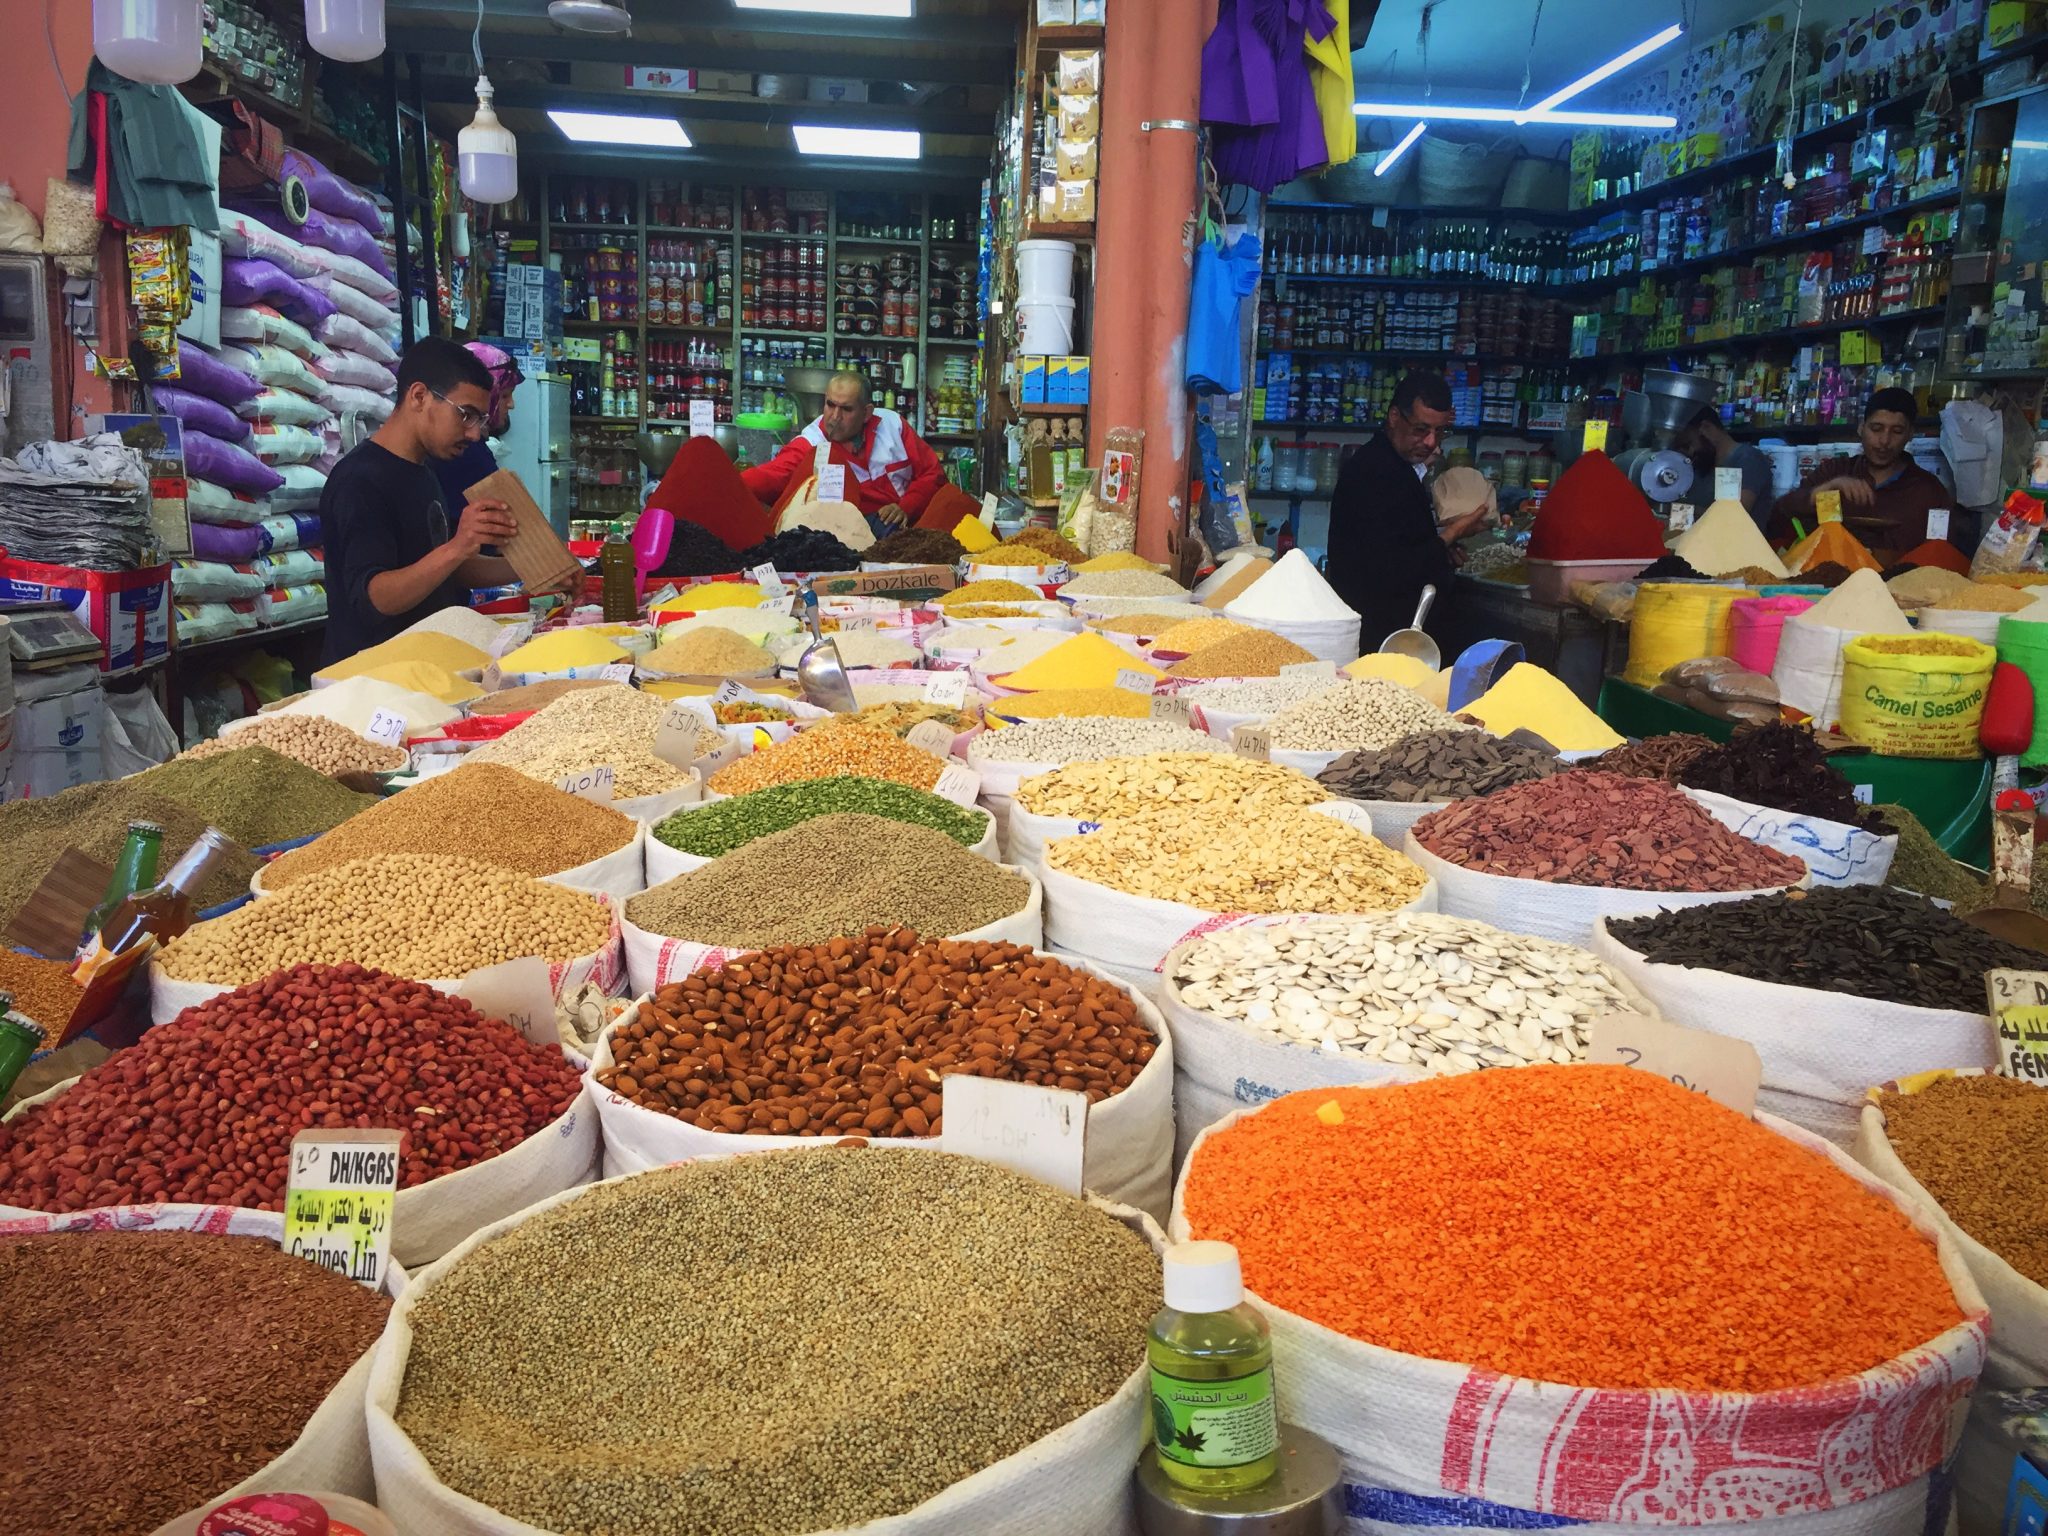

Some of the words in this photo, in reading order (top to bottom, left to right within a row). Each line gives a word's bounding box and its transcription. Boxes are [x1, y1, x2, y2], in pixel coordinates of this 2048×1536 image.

[862, 573, 940, 592] bozkale
[1865, 685, 1918, 717] Camel
[1922, 689, 1983, 718] Sesame
[296, 1147, 319, 1174] 20
[329, 1151, 396, 1185] DH/KGRS
[352, 1239, 377, 1281] Lin
